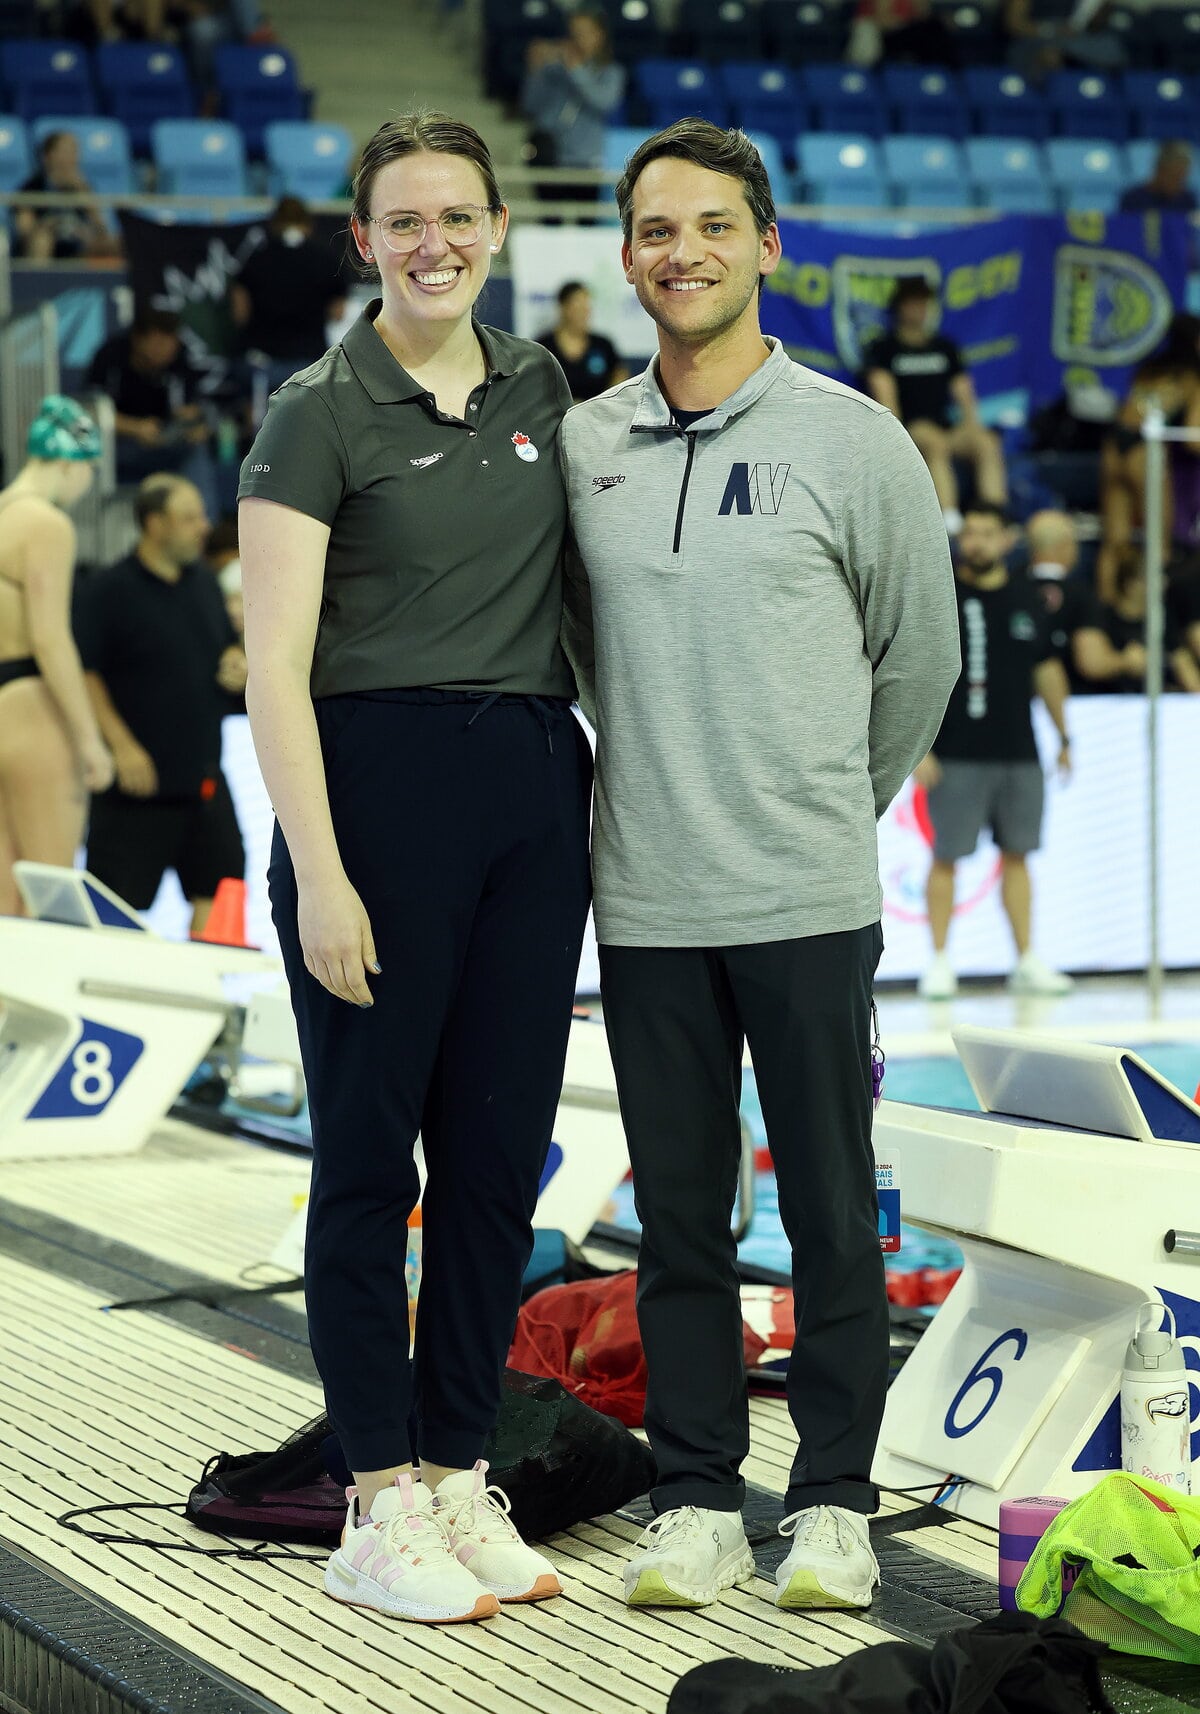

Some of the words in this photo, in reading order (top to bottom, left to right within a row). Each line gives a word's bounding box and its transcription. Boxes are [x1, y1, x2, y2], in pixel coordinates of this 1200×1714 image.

[591, 474, 626, 486] speedo
[70, 1039, 114, 1106] 8
[944, 1328, 1027, 1439] 6
